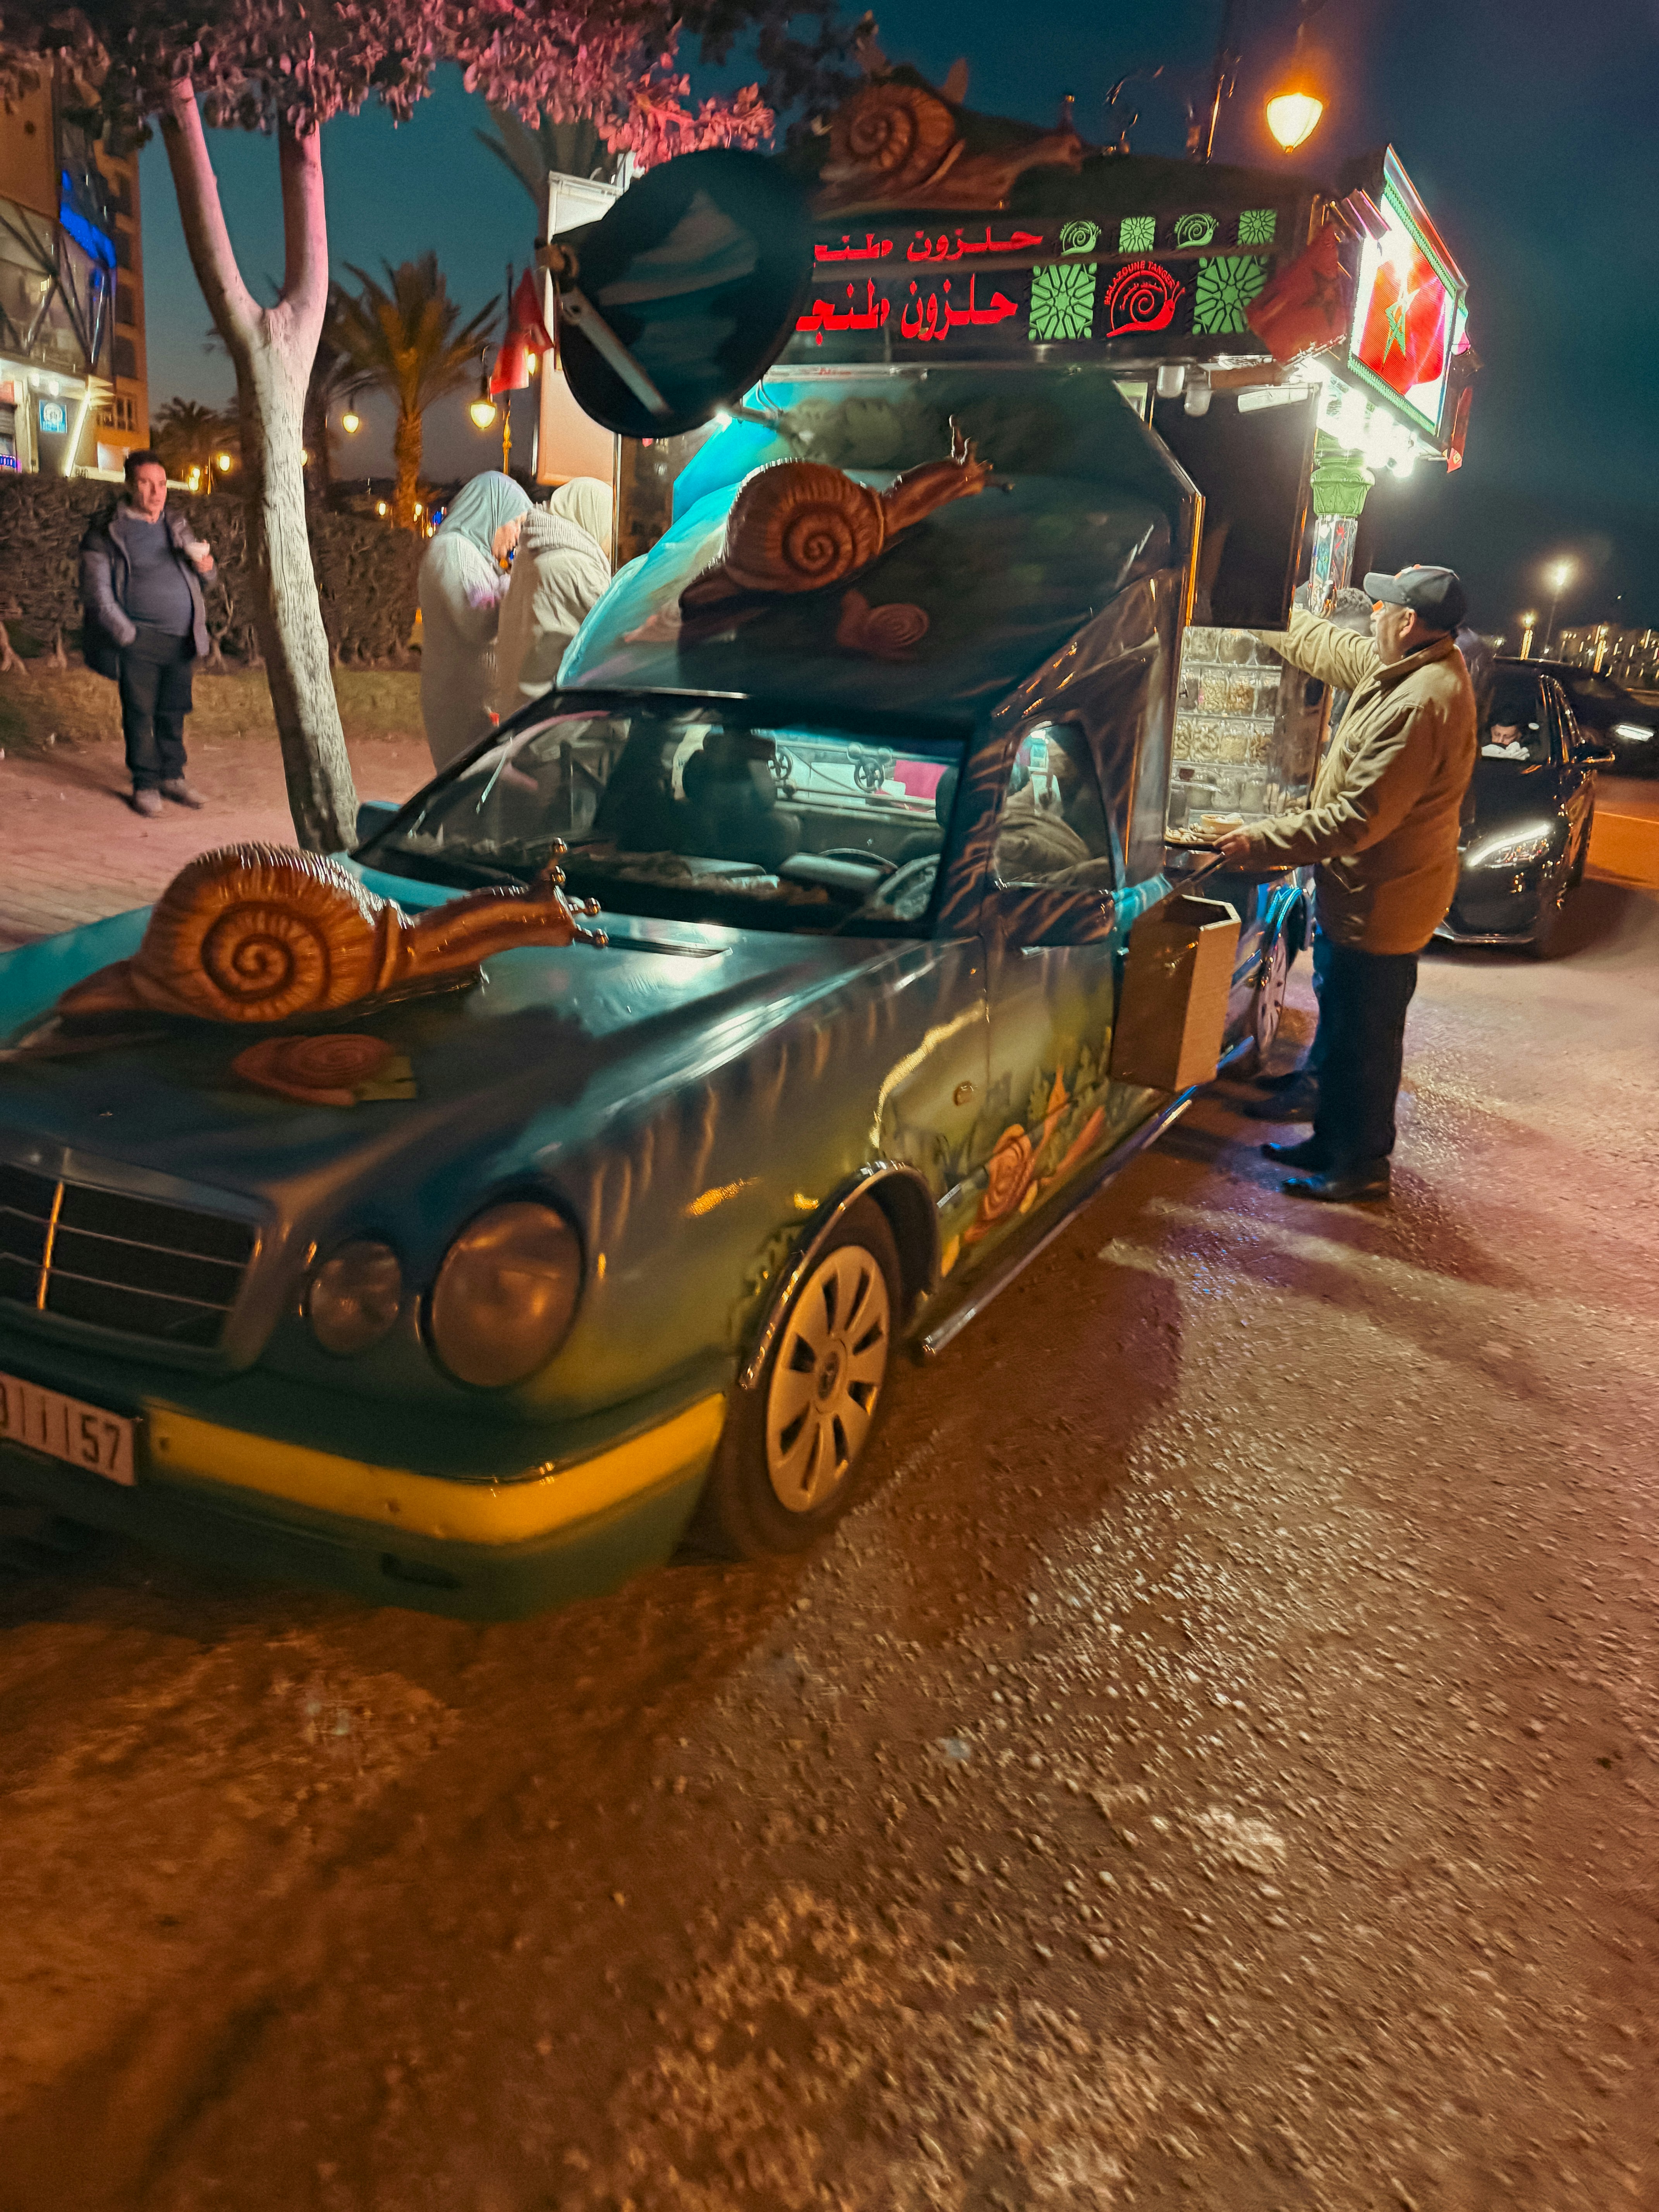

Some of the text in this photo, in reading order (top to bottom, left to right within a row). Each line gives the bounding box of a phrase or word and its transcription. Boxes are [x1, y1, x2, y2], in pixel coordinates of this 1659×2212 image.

[907, 227, 1043, 262] حلزون
[796, 273, 1018, 346] حلزون طنج
